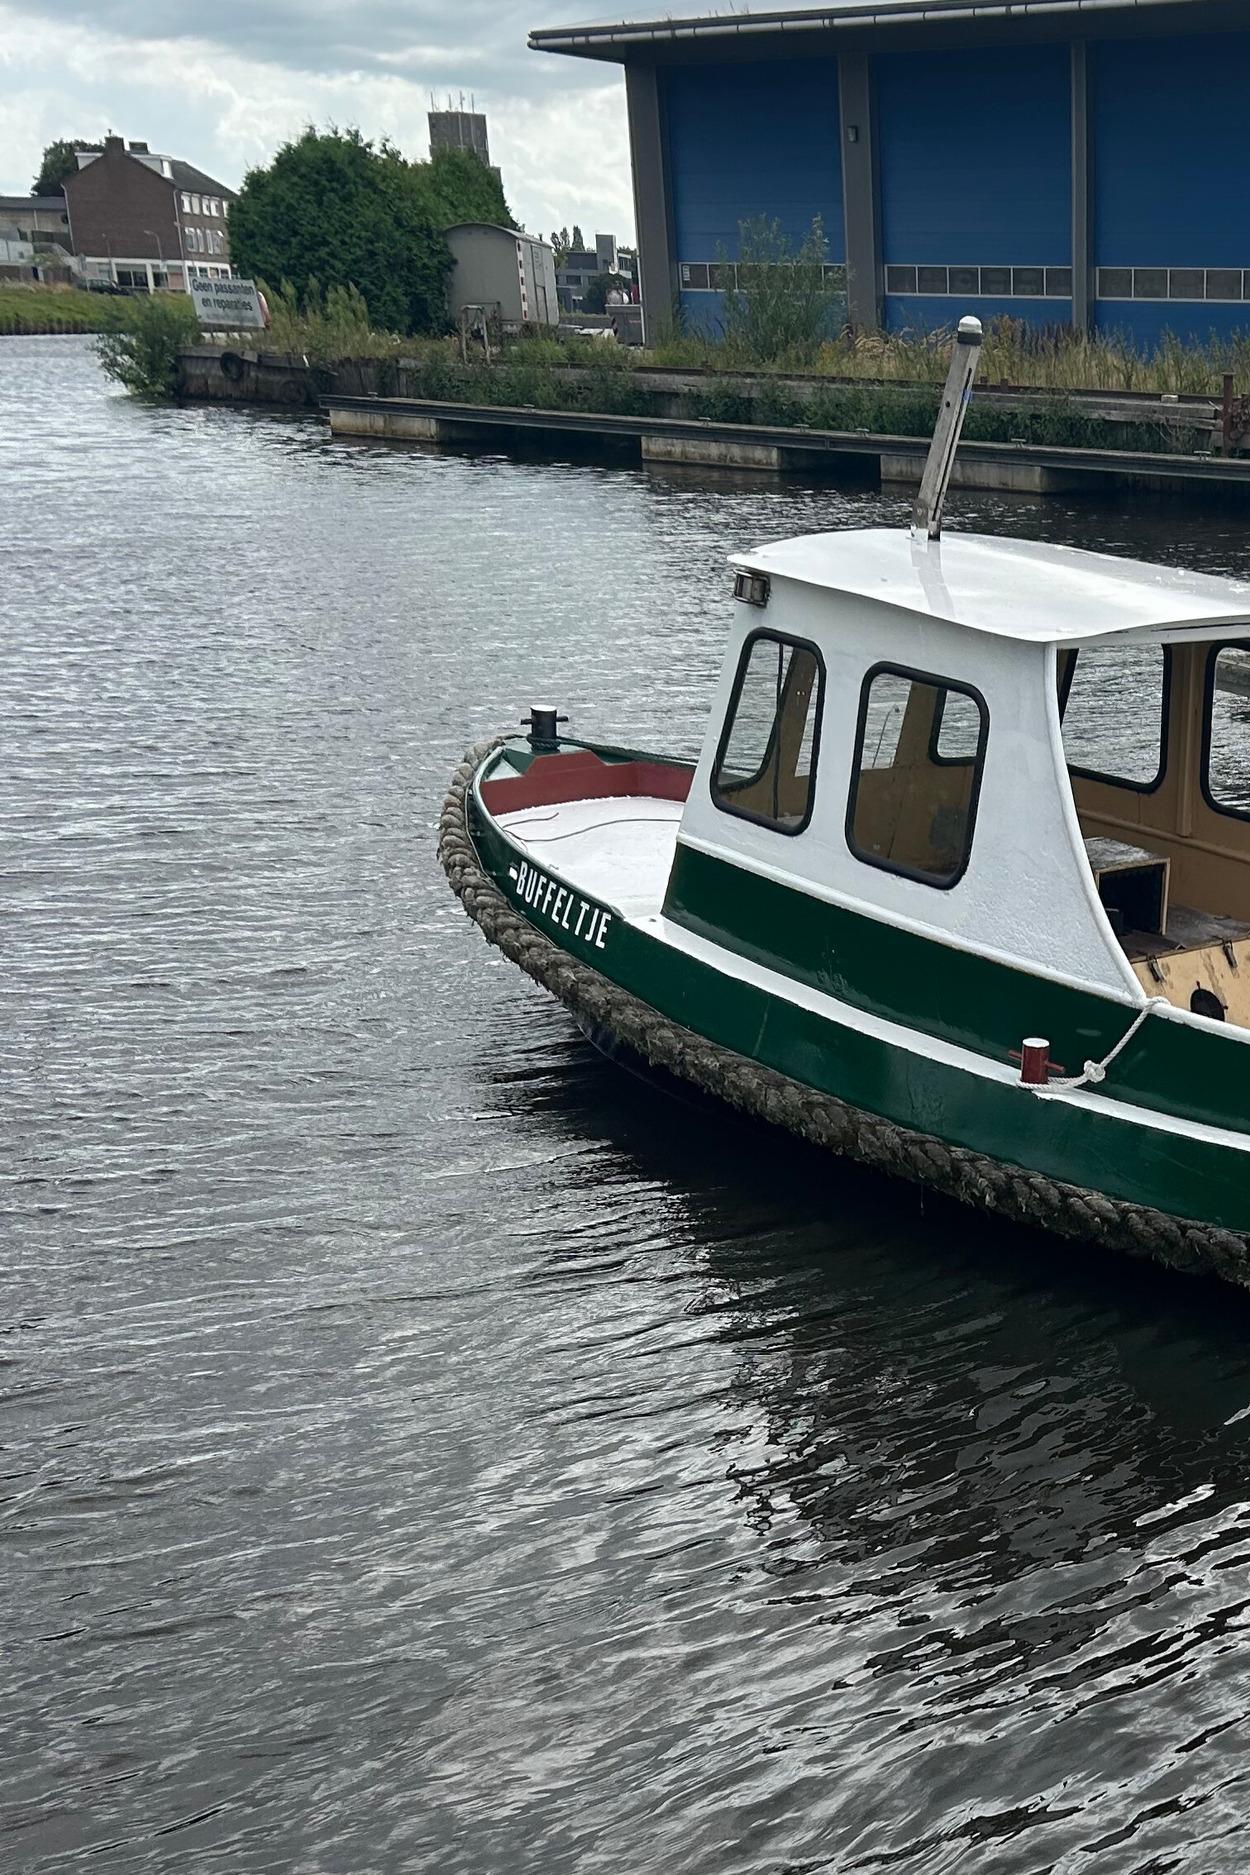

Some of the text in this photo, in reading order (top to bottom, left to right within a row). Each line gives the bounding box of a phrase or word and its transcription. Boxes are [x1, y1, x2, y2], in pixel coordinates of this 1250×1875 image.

[192, 279, 255, 296] Geen passanten
[202, 298, 212, 308] en
[516, 860, 612, 949] BUFFELTJE
